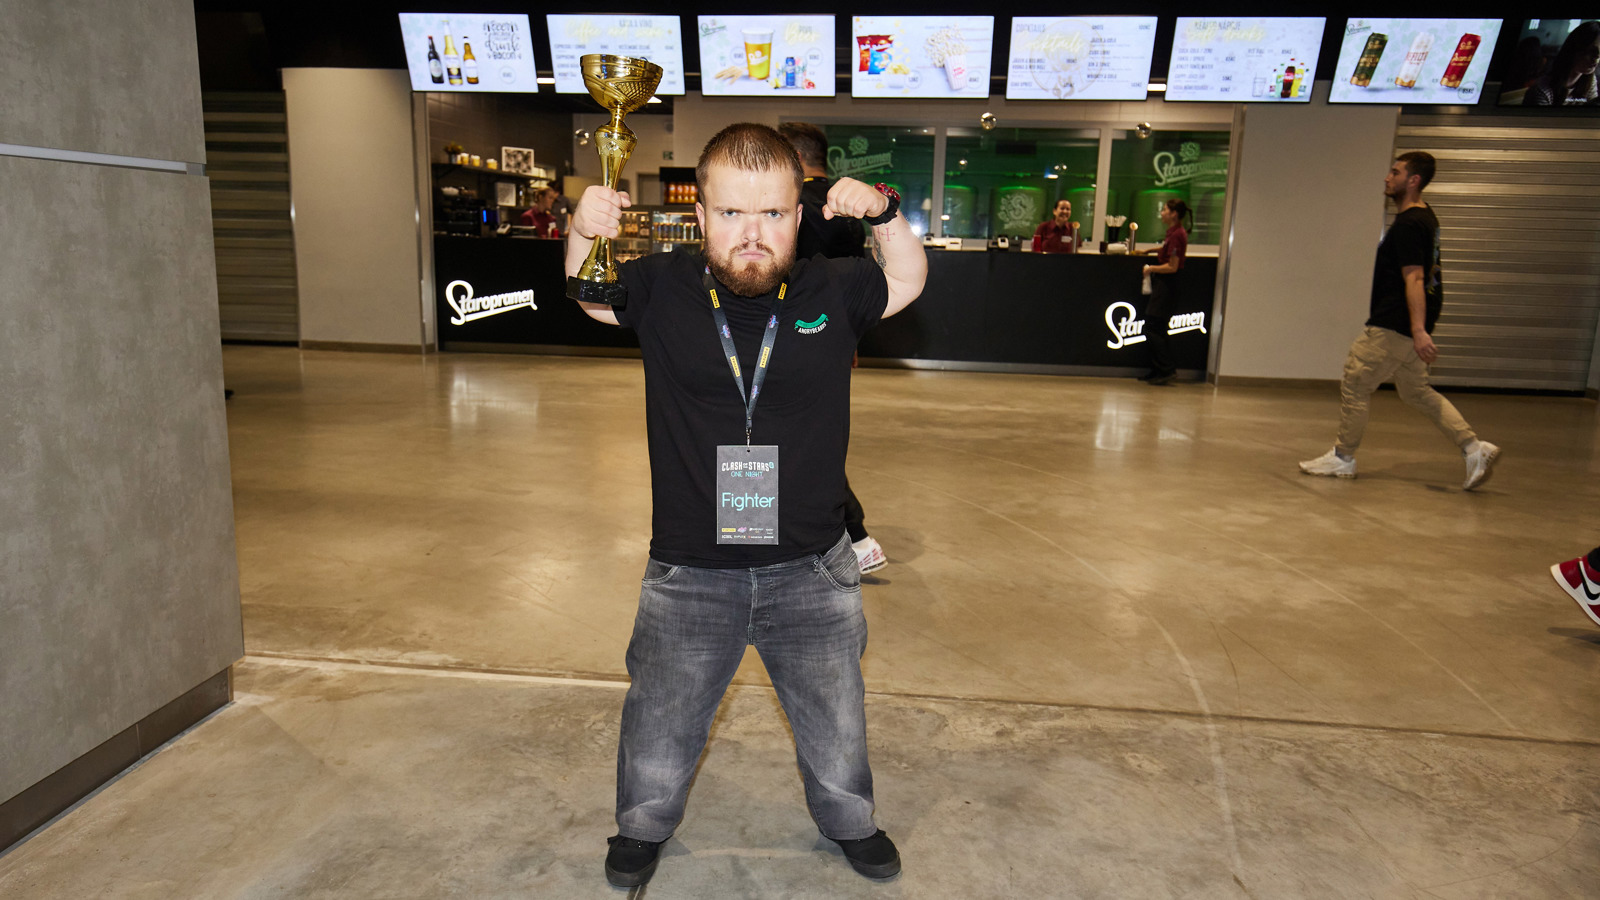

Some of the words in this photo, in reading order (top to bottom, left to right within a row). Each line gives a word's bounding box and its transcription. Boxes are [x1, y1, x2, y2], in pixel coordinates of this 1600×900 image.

[1015, 24, 1046, 33] COCKTAILS
[827, 146, 894, 179] Staropramen
[445, 279, 538, 326] Staropramen
[721, 461, 743, 471] CLASH
[748, 461, 770, 472] STARS
[730, 470, 743, 478] ONE
[745, 470, 763, 478] NIGHT
[721, 491, 775, 512] Fighter
